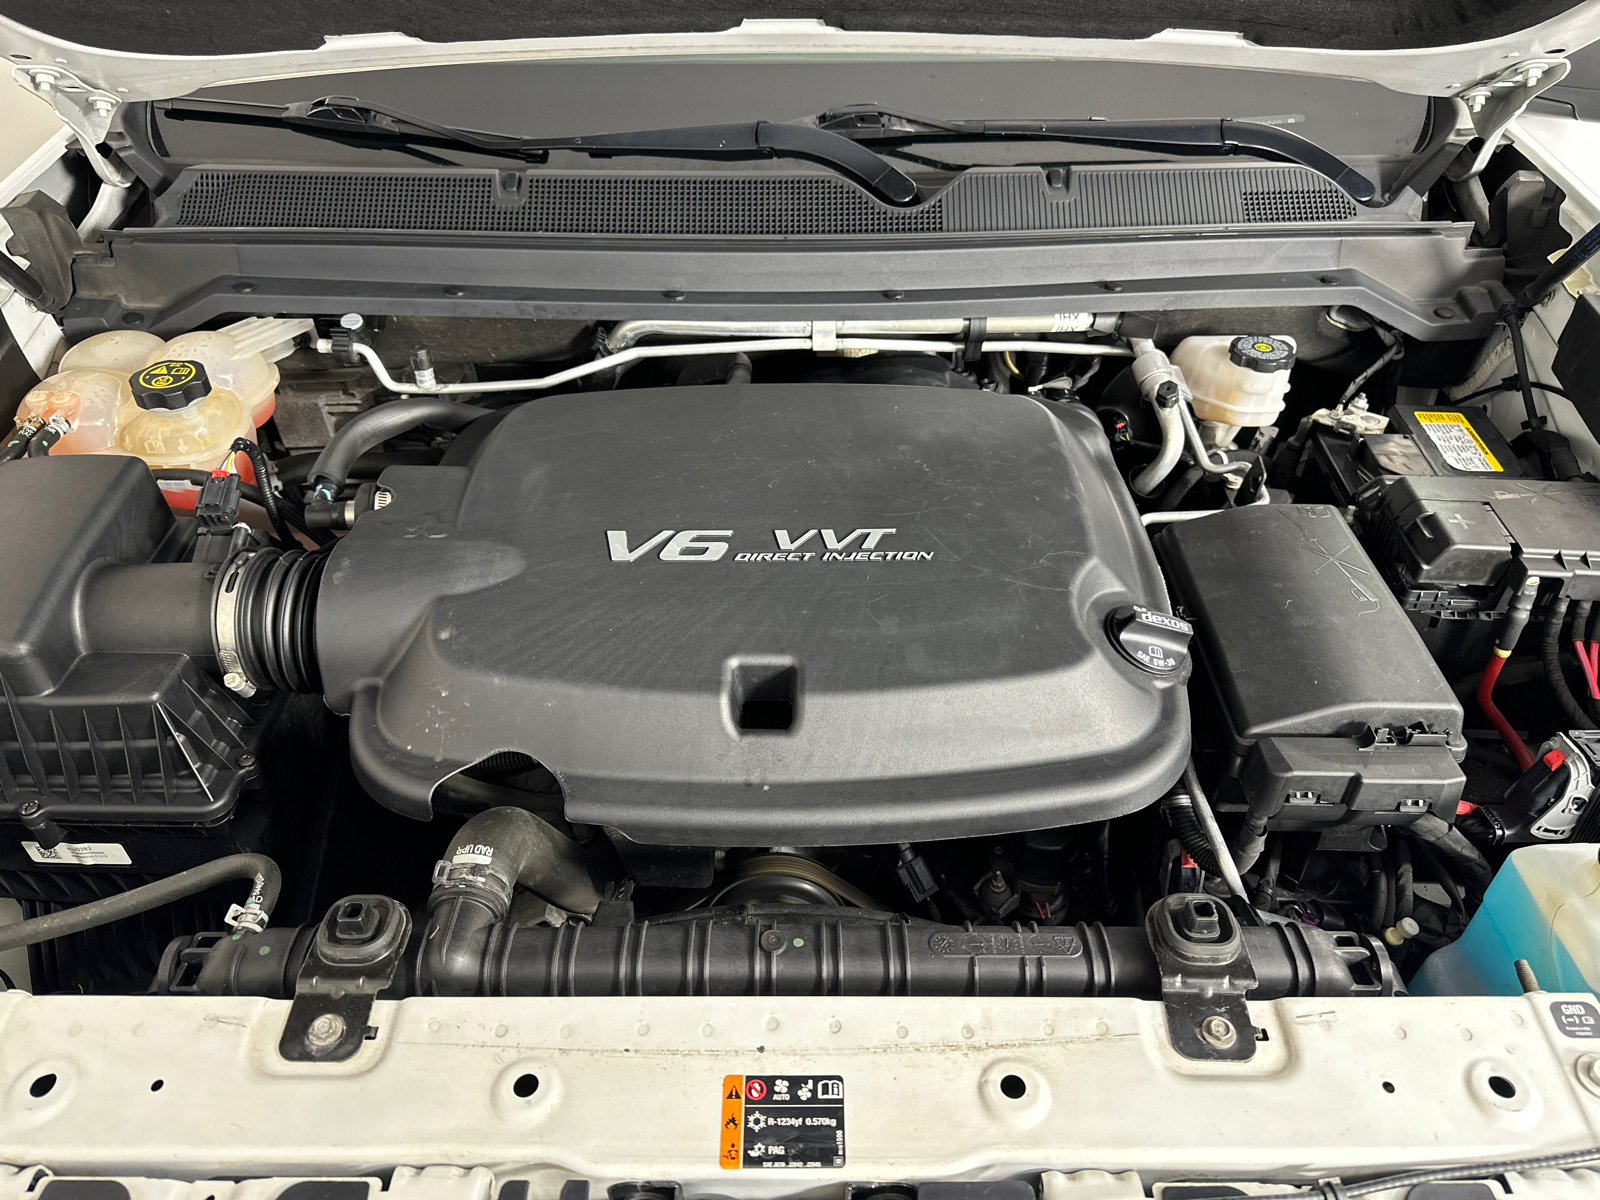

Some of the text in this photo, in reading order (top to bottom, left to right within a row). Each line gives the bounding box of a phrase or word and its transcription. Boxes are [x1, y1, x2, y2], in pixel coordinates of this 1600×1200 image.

[772, 528, 897, 550] VVT
[605, 530, 734, 562] V6
[733, 551, 934, 562] DIRECT INJECTION
[1141, 611, 1189, 632] dexos
[1136, 651, 1151, 663] SAE
[474, 845, 494, 857] RAD
[1561, 1004, 1586, 1015] GND
[767, 1117, 837, 1127] R-1234yf 0.570kg
[768, 1146, 786, 1155] PAG
